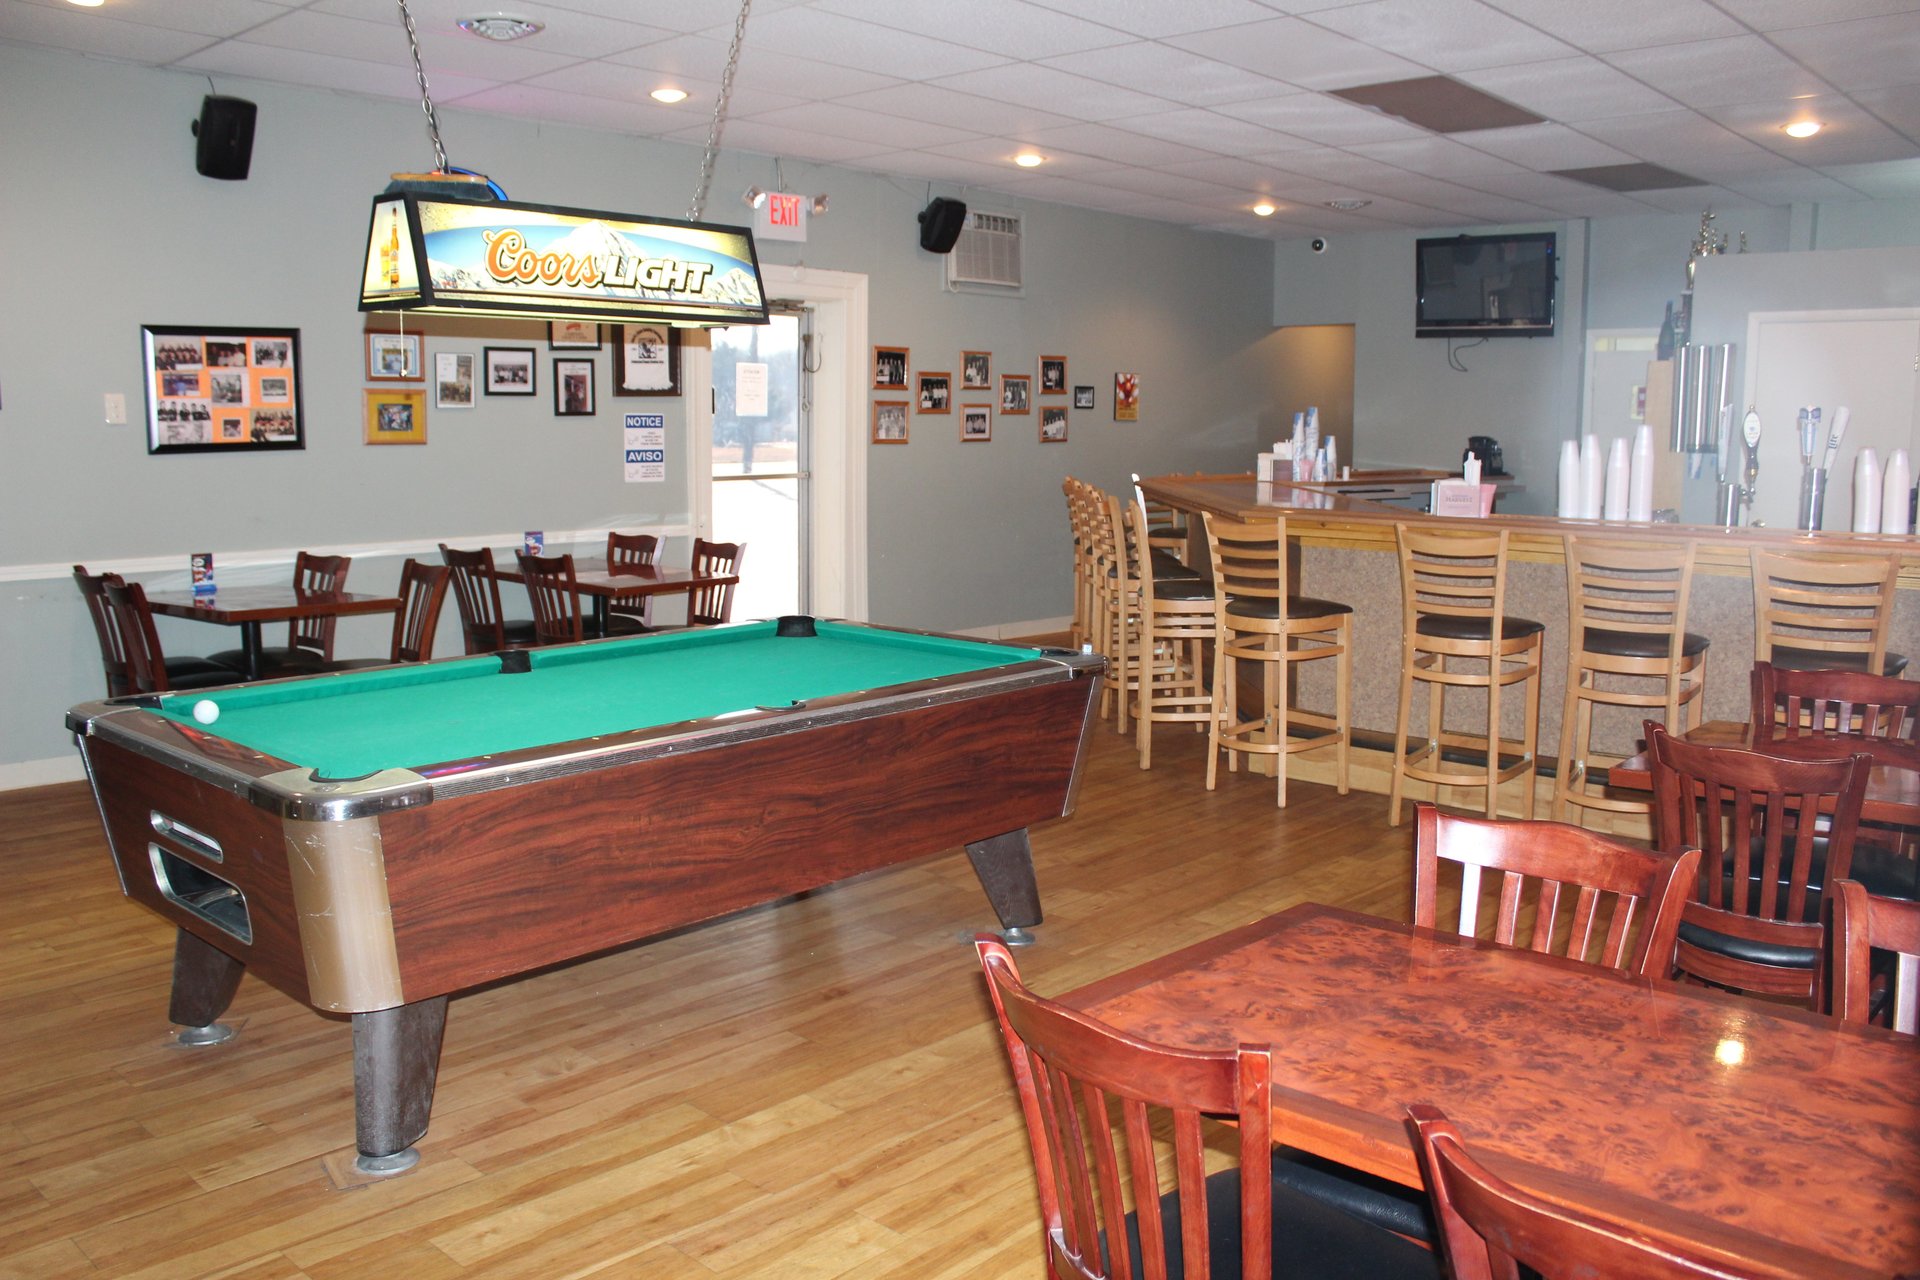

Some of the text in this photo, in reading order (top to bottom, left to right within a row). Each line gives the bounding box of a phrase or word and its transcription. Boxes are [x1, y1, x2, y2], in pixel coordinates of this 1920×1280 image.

[769, 194, 801, 227] EXIT
[482, 229, 713, 293] Coors LIGHT
[626, 416, 662, 427] NOTICE
[627, 451, 662, 462] AVISO
